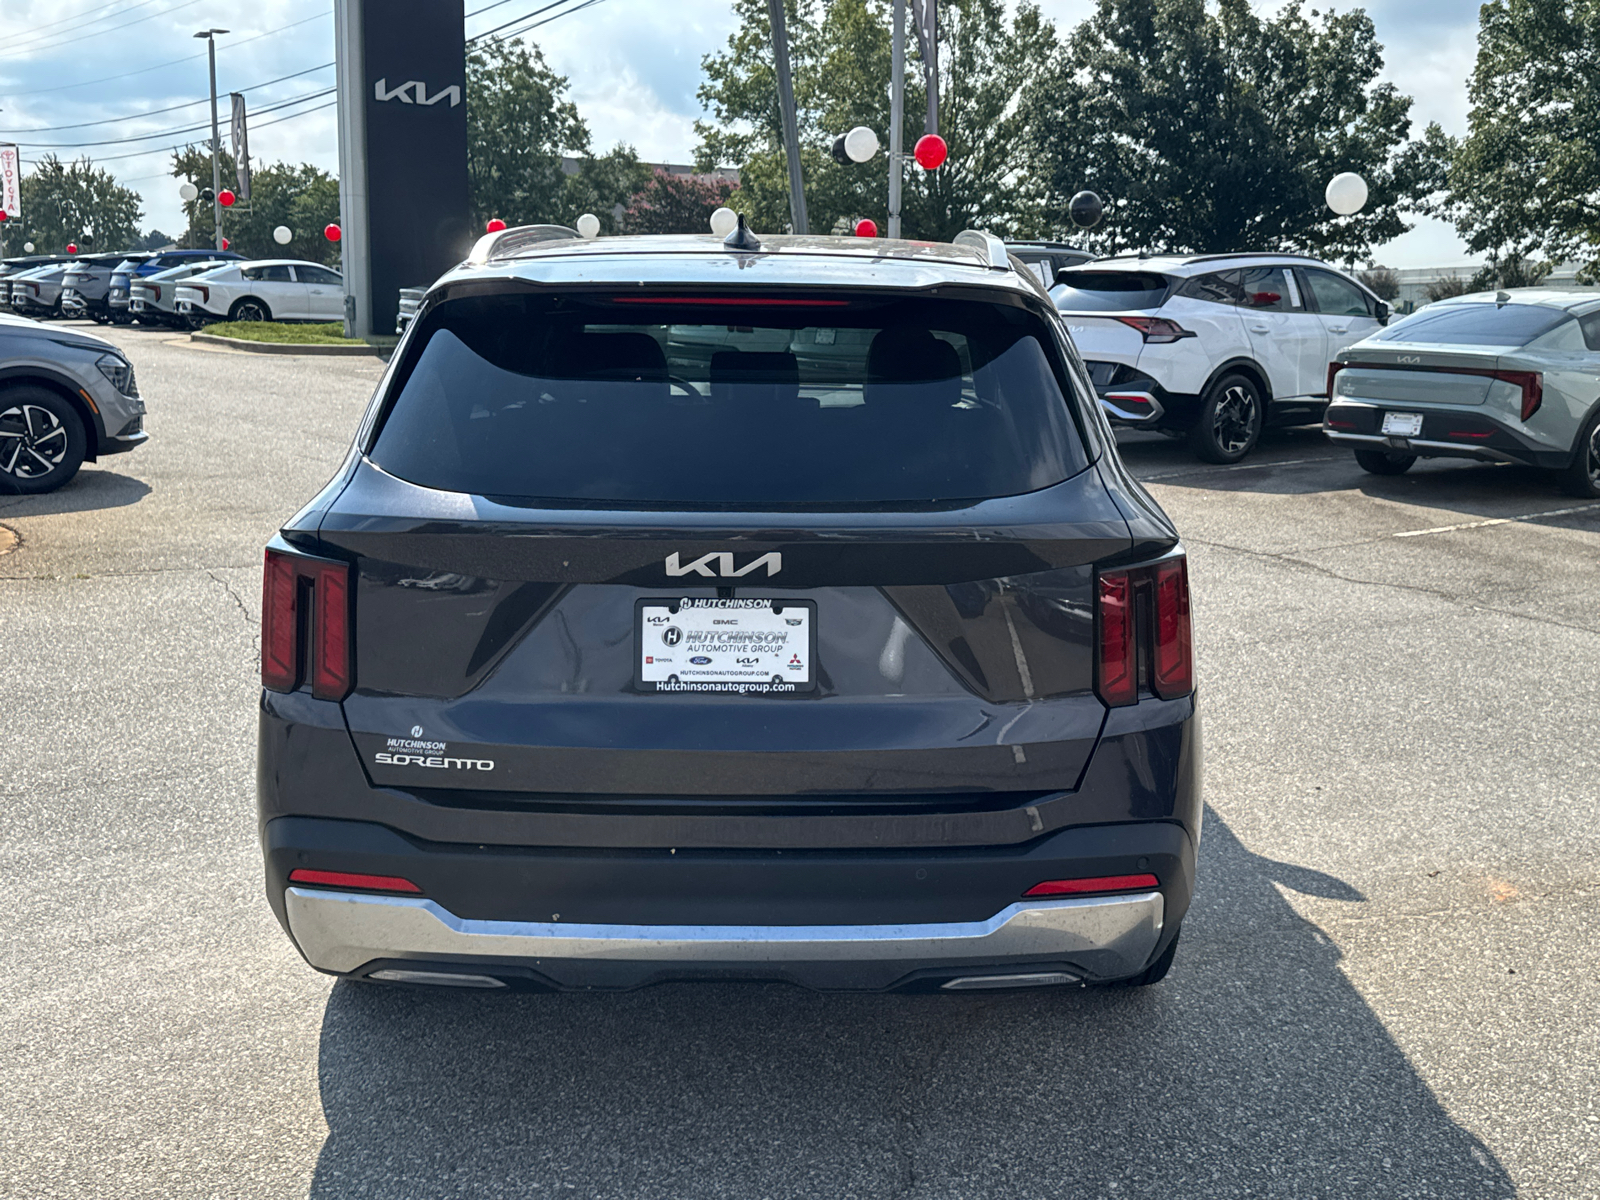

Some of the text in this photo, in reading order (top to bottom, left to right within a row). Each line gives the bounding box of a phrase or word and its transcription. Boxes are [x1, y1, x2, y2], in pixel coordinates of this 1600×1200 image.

[375, 78, 461, 108] KIA
[4, 161, 15, 211] TOYOTA
[1397, 355, 1421, 363] KIA
[665, 551, 782, 577] KIA
[694, 599, 772, 609] HUTCHINSON
[685, 630, 788, 644] HUTCHINSON
[687, 644, 783, 653] AUTOMOTIVE GROUP
[656, 681, 795, 693] Hutchinsonautogroup.com
[387, 738, 446, 750] HUTCHINSON
[388, 746, 423, 755] AUTOMOTIVE
[375, 752, 495, 771] SORENTO
